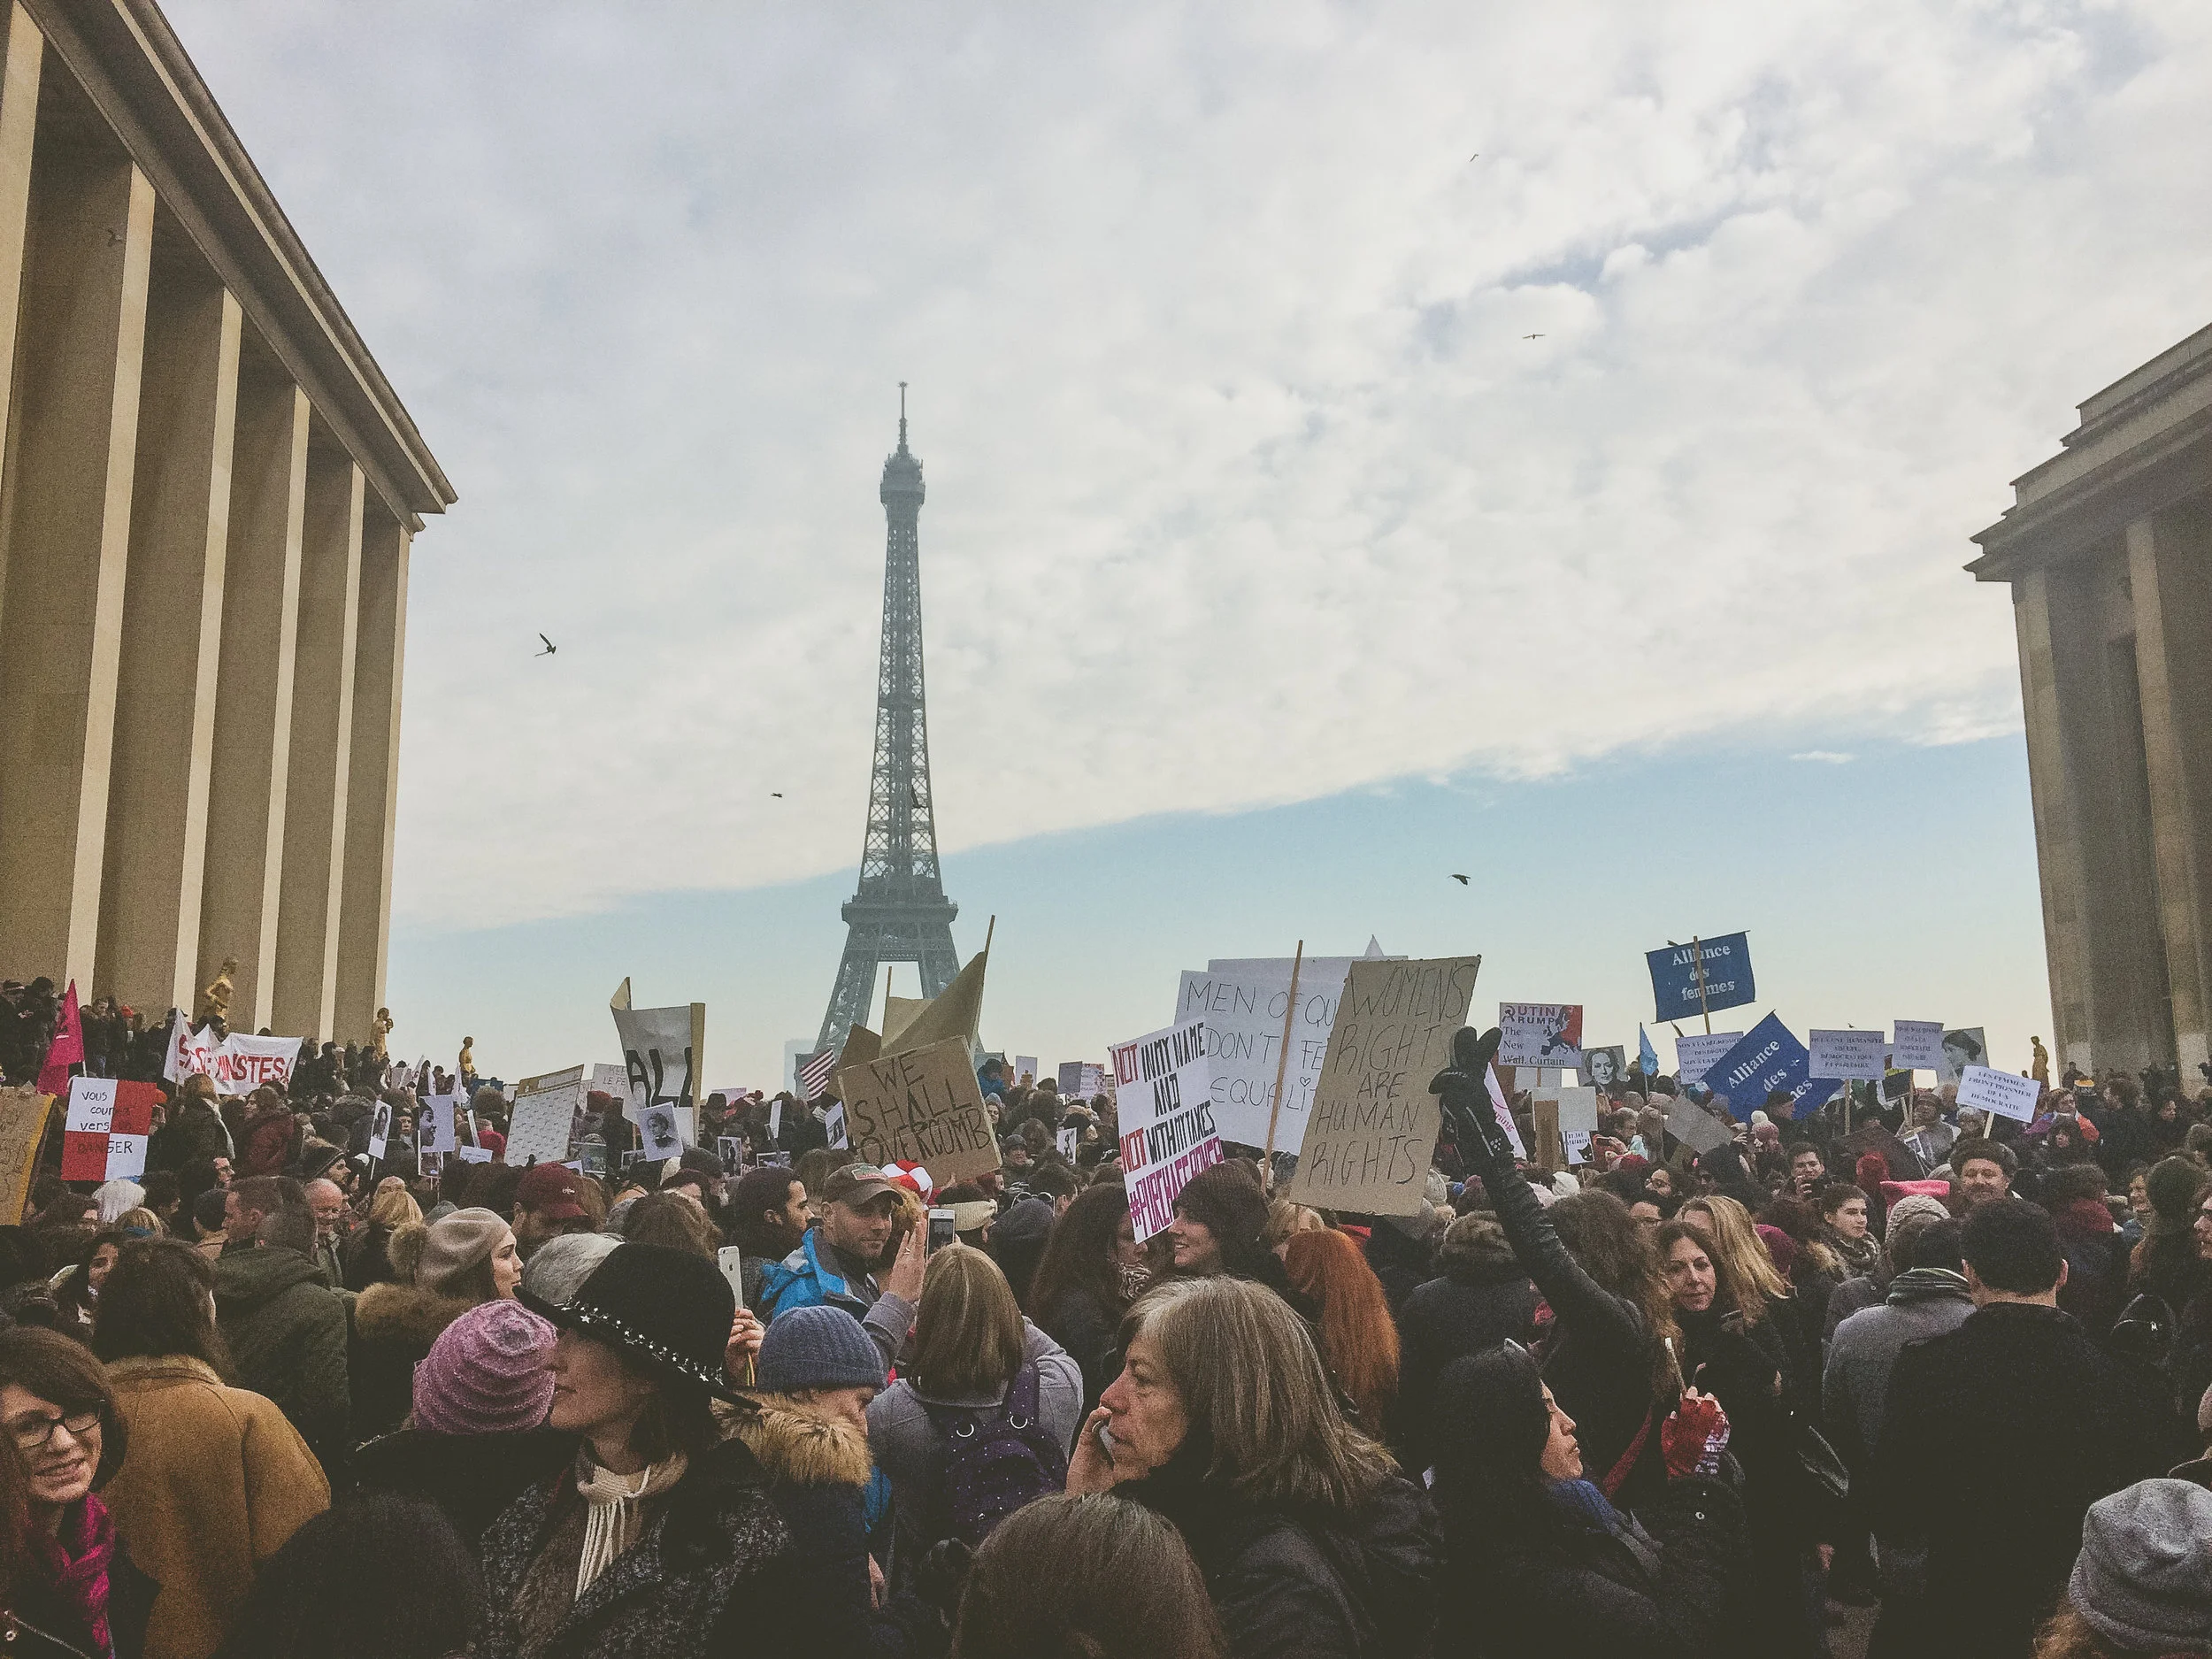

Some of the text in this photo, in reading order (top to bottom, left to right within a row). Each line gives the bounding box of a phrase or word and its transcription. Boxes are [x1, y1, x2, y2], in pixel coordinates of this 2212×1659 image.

[1187, 979, 1256, 1014] MEN
[1304, 995, 1337, 1028] QU
[1349, 961, 1476, 1022] WOMEN'S
[1205, 1026, 1328, 1070] DON'T FE
[1334, 1023, 1458, 1076] RIGHTS
[1503, 1026, 1522, 1036] The
[1503, 1040, 1525, 1049] New
[869, 1048, 926, 1093] WE
[1111, 1042, 1139, 1088] NOT
[1171, 1021, 1206, 1069] NAME
[1529, 1056, 1565, 1065] Curtain
[1727, 1040, 1781, 1089] Alliance
[1153, 1071, 1181, 1118] AND
[1210, 1076, 1317, 1112] EQUALI
[1356, 1071, 1406, 1100] ARE
[1763, 1067, 1788, 1094] des
[80, 1121, 110, 1132] vers
[854, 1078, 972, 1137] SHALL
[1314, 1100, 1421, 1136] HUMAN
[77, 1141, 134, 1155] DANGER
[1119, 1126, 1148, 1175] NOT
[1308, 1134, 1423, 1187] RIGHTS
